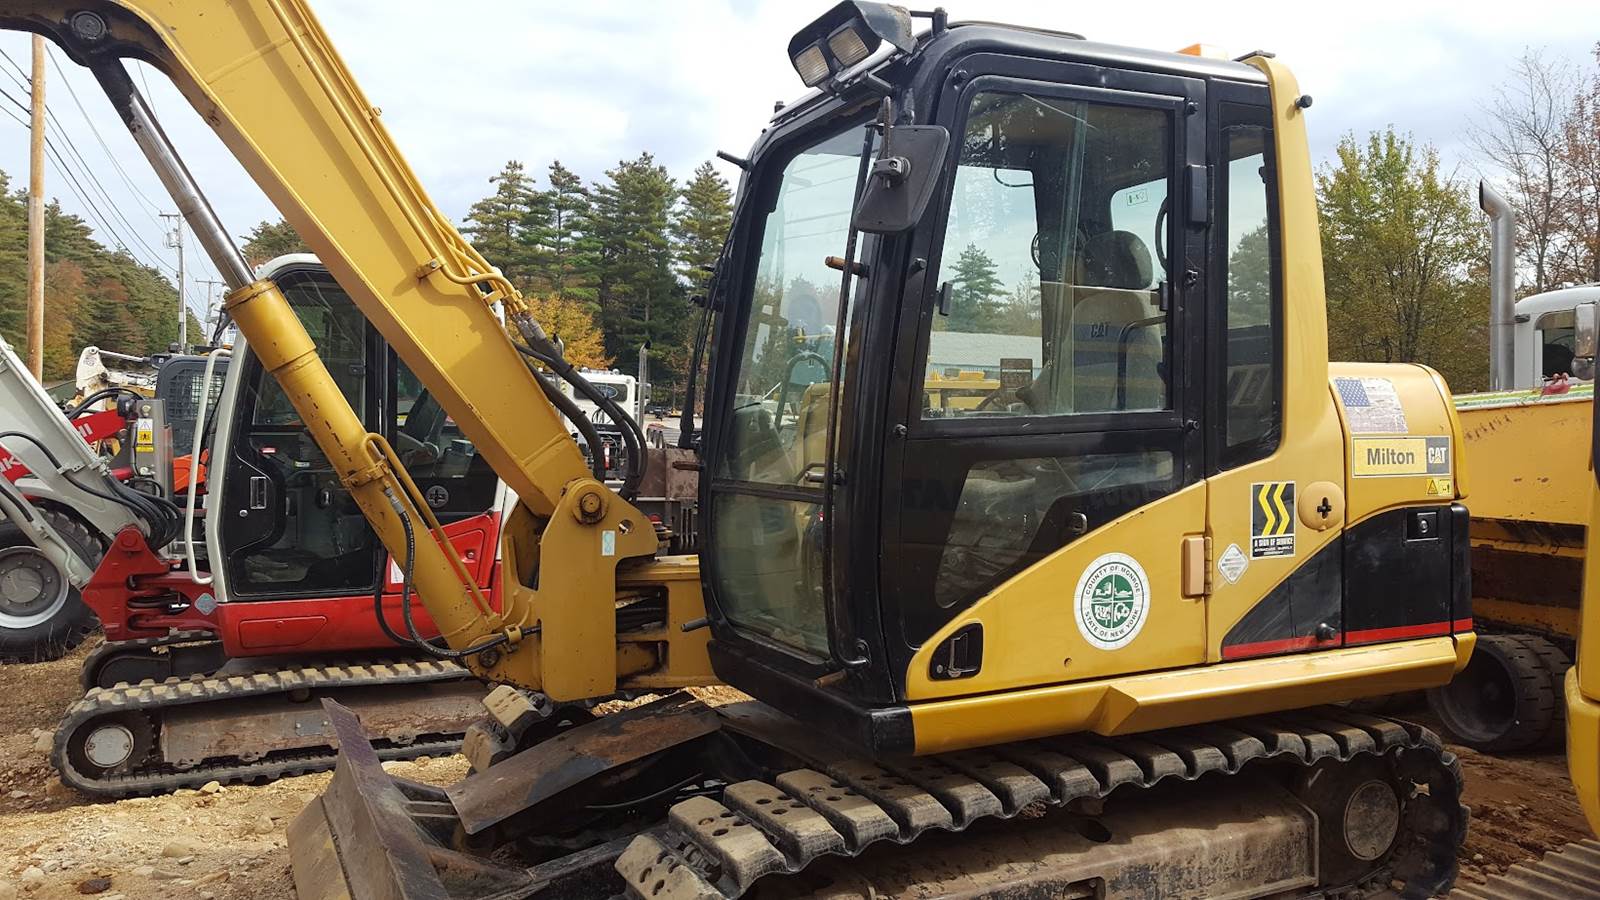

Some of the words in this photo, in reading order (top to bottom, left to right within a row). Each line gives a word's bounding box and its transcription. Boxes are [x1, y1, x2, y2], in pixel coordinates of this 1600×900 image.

[1367, 448, 1415, 465] Milton
[1427, 447, 1447, 464] CAT
[1270, 538, 1276, 546] OF
[1276, 537, 1293, 546] SERVICE
[1085, 567, 1107, 595] COUNTY
[1120, 567, 1141, 593] MONROE
[1085, 611, 1099, 632] STATE
[1110, 629, 1125, 637] NEW
[1126, 609, 1139, 629] YORK
